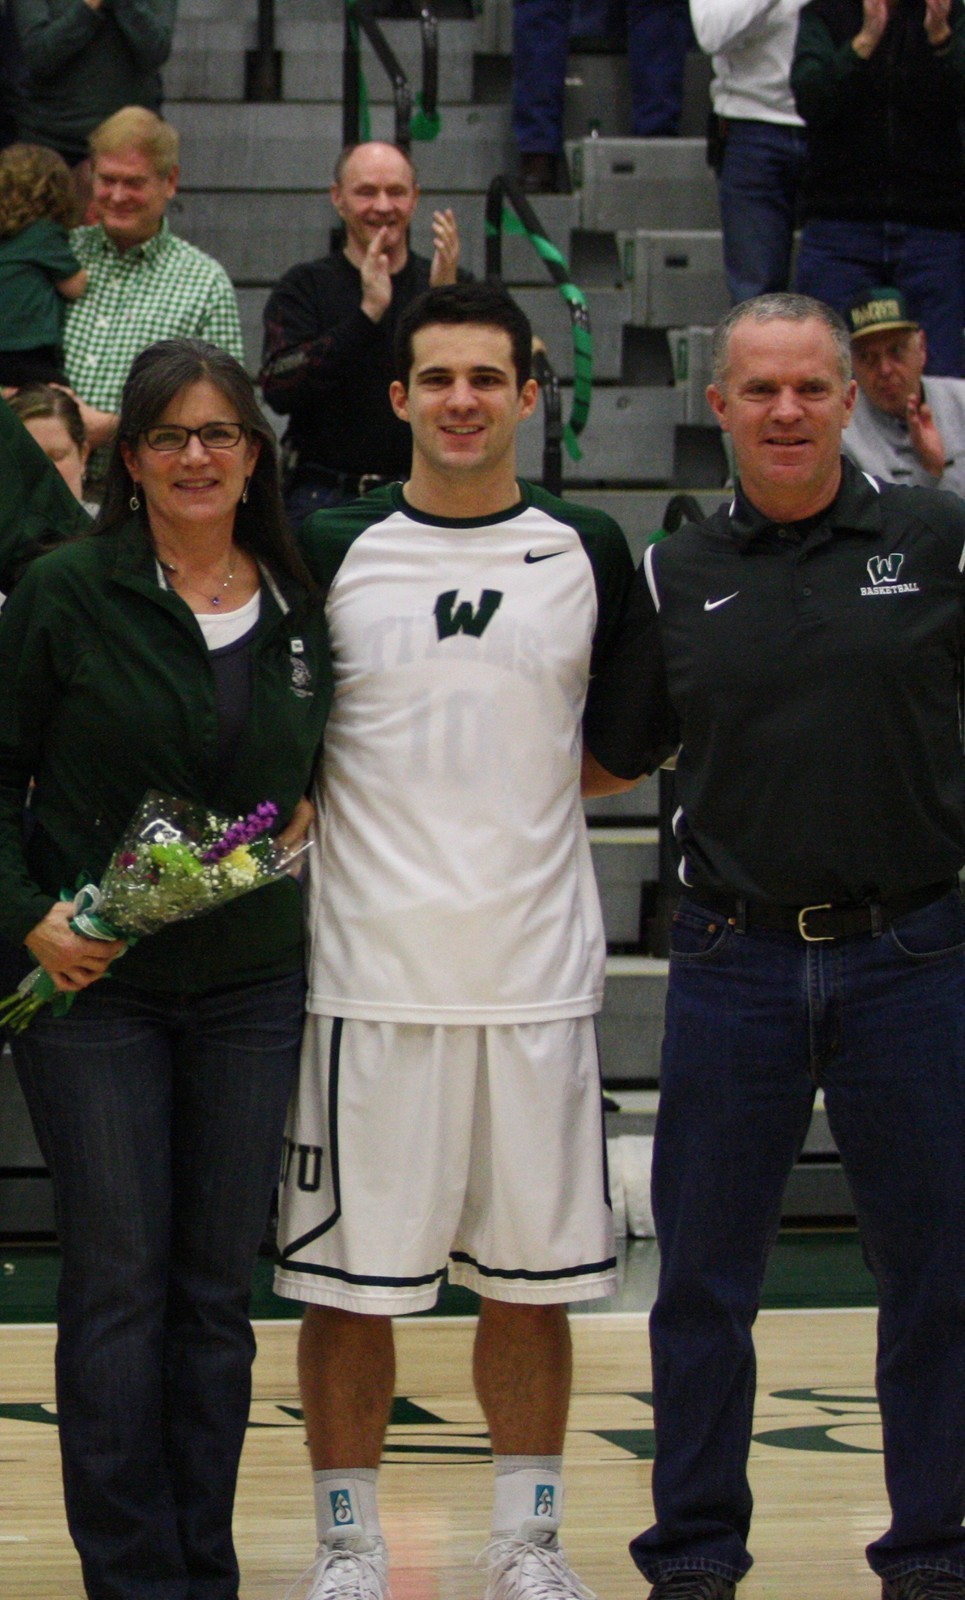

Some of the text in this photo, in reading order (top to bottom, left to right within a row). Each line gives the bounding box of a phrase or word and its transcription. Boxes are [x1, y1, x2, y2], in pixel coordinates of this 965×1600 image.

[867, 552, 904, 586] W
[860, 582, 920, 596] BASKETBALL
[433, 588, 504, 643] W
